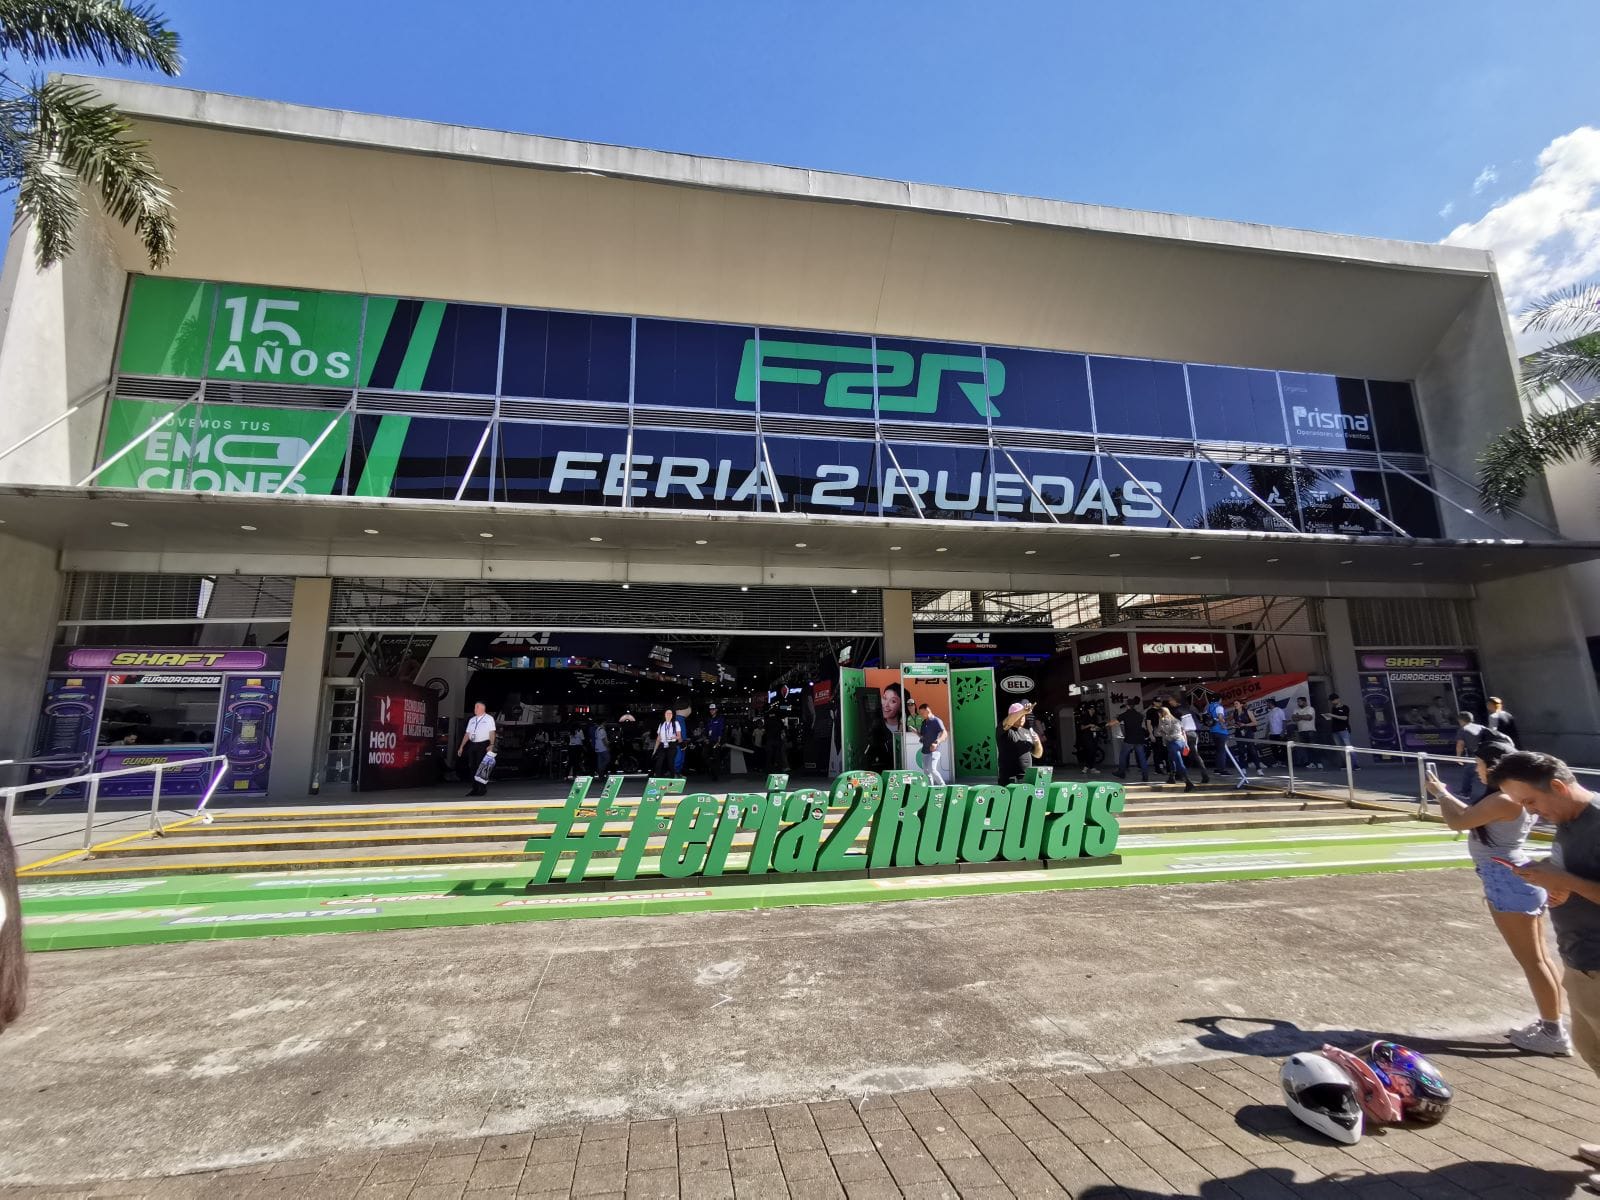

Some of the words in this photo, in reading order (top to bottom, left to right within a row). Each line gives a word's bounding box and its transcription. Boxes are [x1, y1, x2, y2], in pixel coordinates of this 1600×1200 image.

[224, 296, 300, 346] 15
[216, 340, 351, 379] AÑOS
[734, 339, 1006, 418] F2R
[1292, 406, 1369, 431] Prisma
[240, 421, 271, 431] TUS
[549, 450, 784, 503] FERIA
[810, 464, 855, 506] 2
[884, 467, 1163, 518] RUEDAS
[112, 653, 224, 666] SHAFT
[1385, 657, 1444, 667] SHAFT
[140, 676, 221, 684] GUARDACASCOS
[1007, 680, 1030, 689] BELL
[369, 731, 396, 749] Hero
[121, 757, 168, 765] GUARDA
[369, 751, 395, 764] MOTOS
